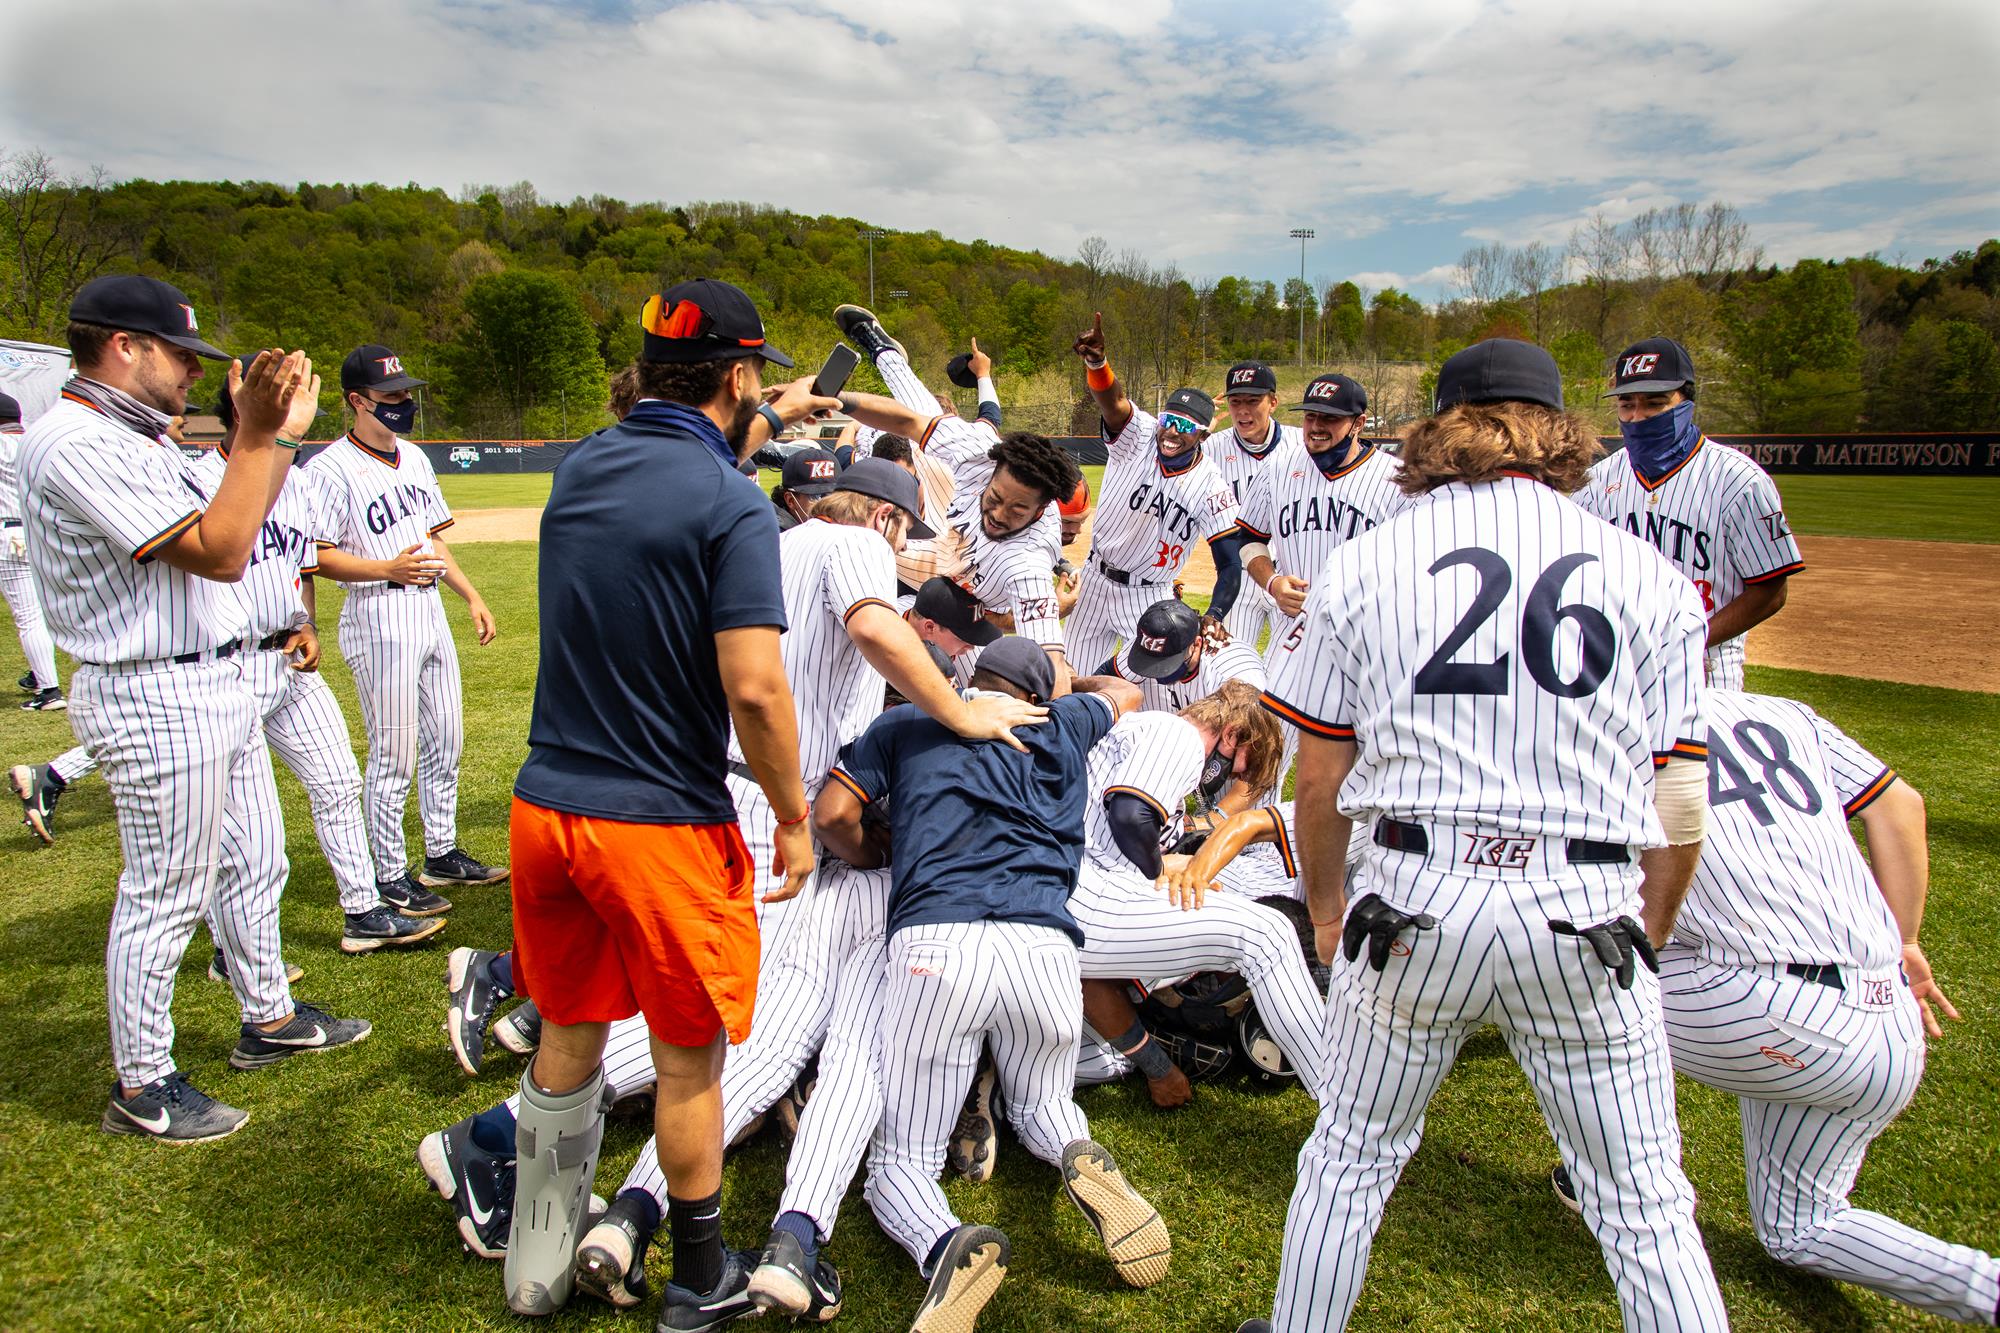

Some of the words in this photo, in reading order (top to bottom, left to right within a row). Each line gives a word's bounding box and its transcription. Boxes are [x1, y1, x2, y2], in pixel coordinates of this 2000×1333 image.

[1229, 369, 1257, 385] KC
[1622, 353, 1660, 377] KC
[1306, 380, 1342, 400] KC
[384, 410, 401, 421] KC
[1814, 443, 1974, 466] MATHEWSON
[804, 460, 835, 480] KC
[1152, 539, 1184, 570] 39
[1414, 547, 1616, 698] 26
[1139, 628, 1168, 652] KC
[1706, 719, 1823, 828] 48
[1460, 832, 1537, 869] KC
[1861, 979, 1893, 1006] KC
